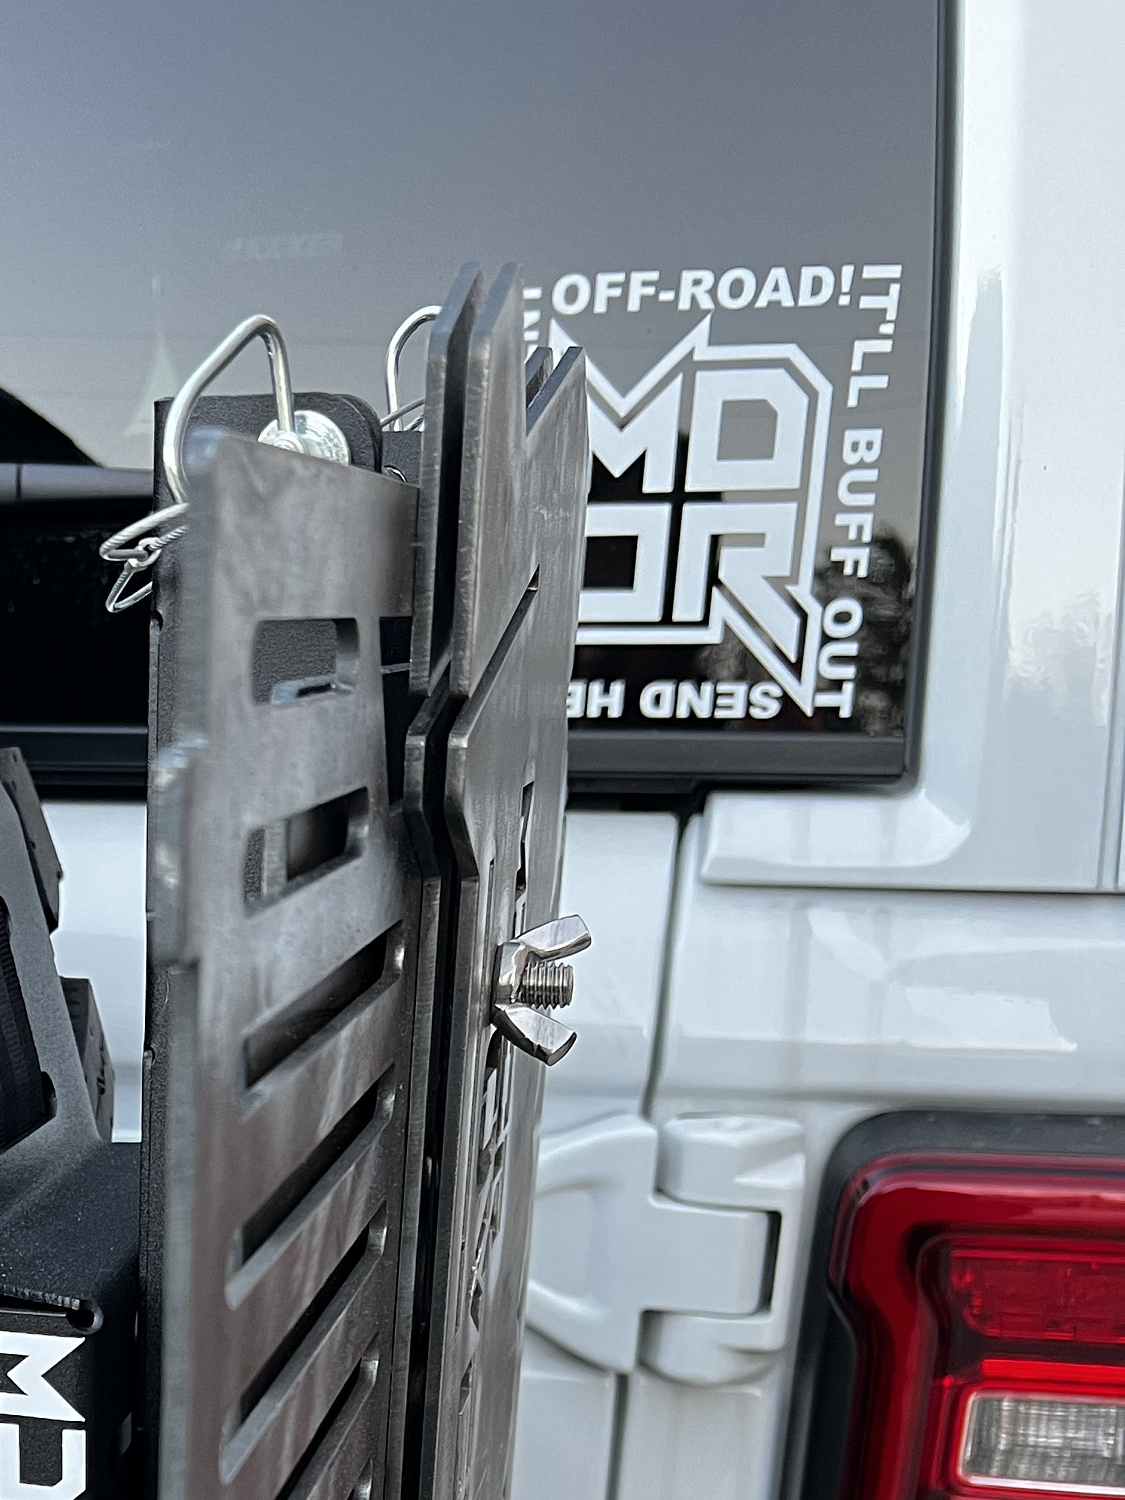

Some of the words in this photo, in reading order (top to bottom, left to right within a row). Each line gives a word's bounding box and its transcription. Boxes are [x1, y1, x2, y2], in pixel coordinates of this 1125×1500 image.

[552, 264, 855, 314] OFF-ROAD!
[845, 264, 903, 408] IT'LL
[829, 427, 884, 579] BUFF
[639, 679, 784, 719] SEND
[812, 598, 863, 719] OUT
